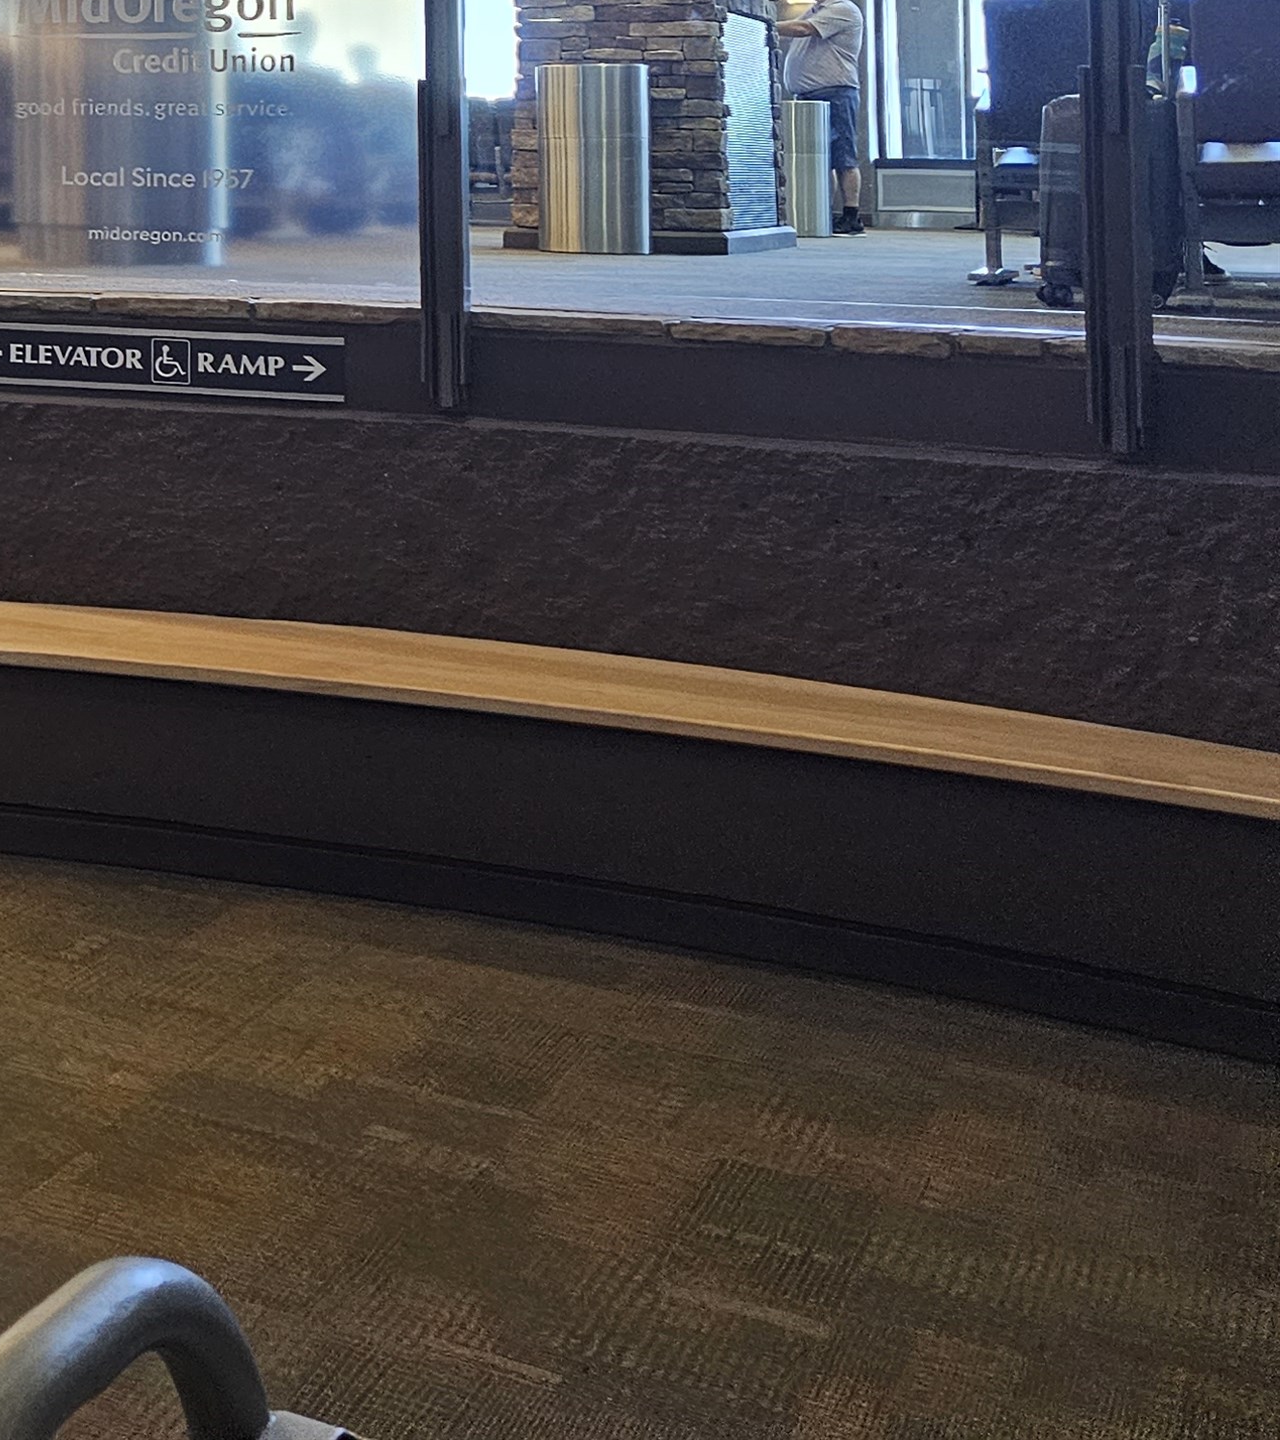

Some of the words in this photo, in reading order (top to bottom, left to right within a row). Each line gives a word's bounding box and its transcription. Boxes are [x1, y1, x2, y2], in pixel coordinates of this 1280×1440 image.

[113, 47, 202, 74] Credit
[209, 47, 295, 73] Union
[14, 98, 65, 120] good
[72, 98, 150, 117] friends.
[154, 101, 208, 120] grea
[61, 165, 124, 188] Local
[132, 167, 196, 189] Since
[203, 169, 254, 189] 1957
[88, 226, 223, 245] midoregon.com
[9, 343, 144, 370] ELEVATOR
[197, 352, 286, 377] RAMP
